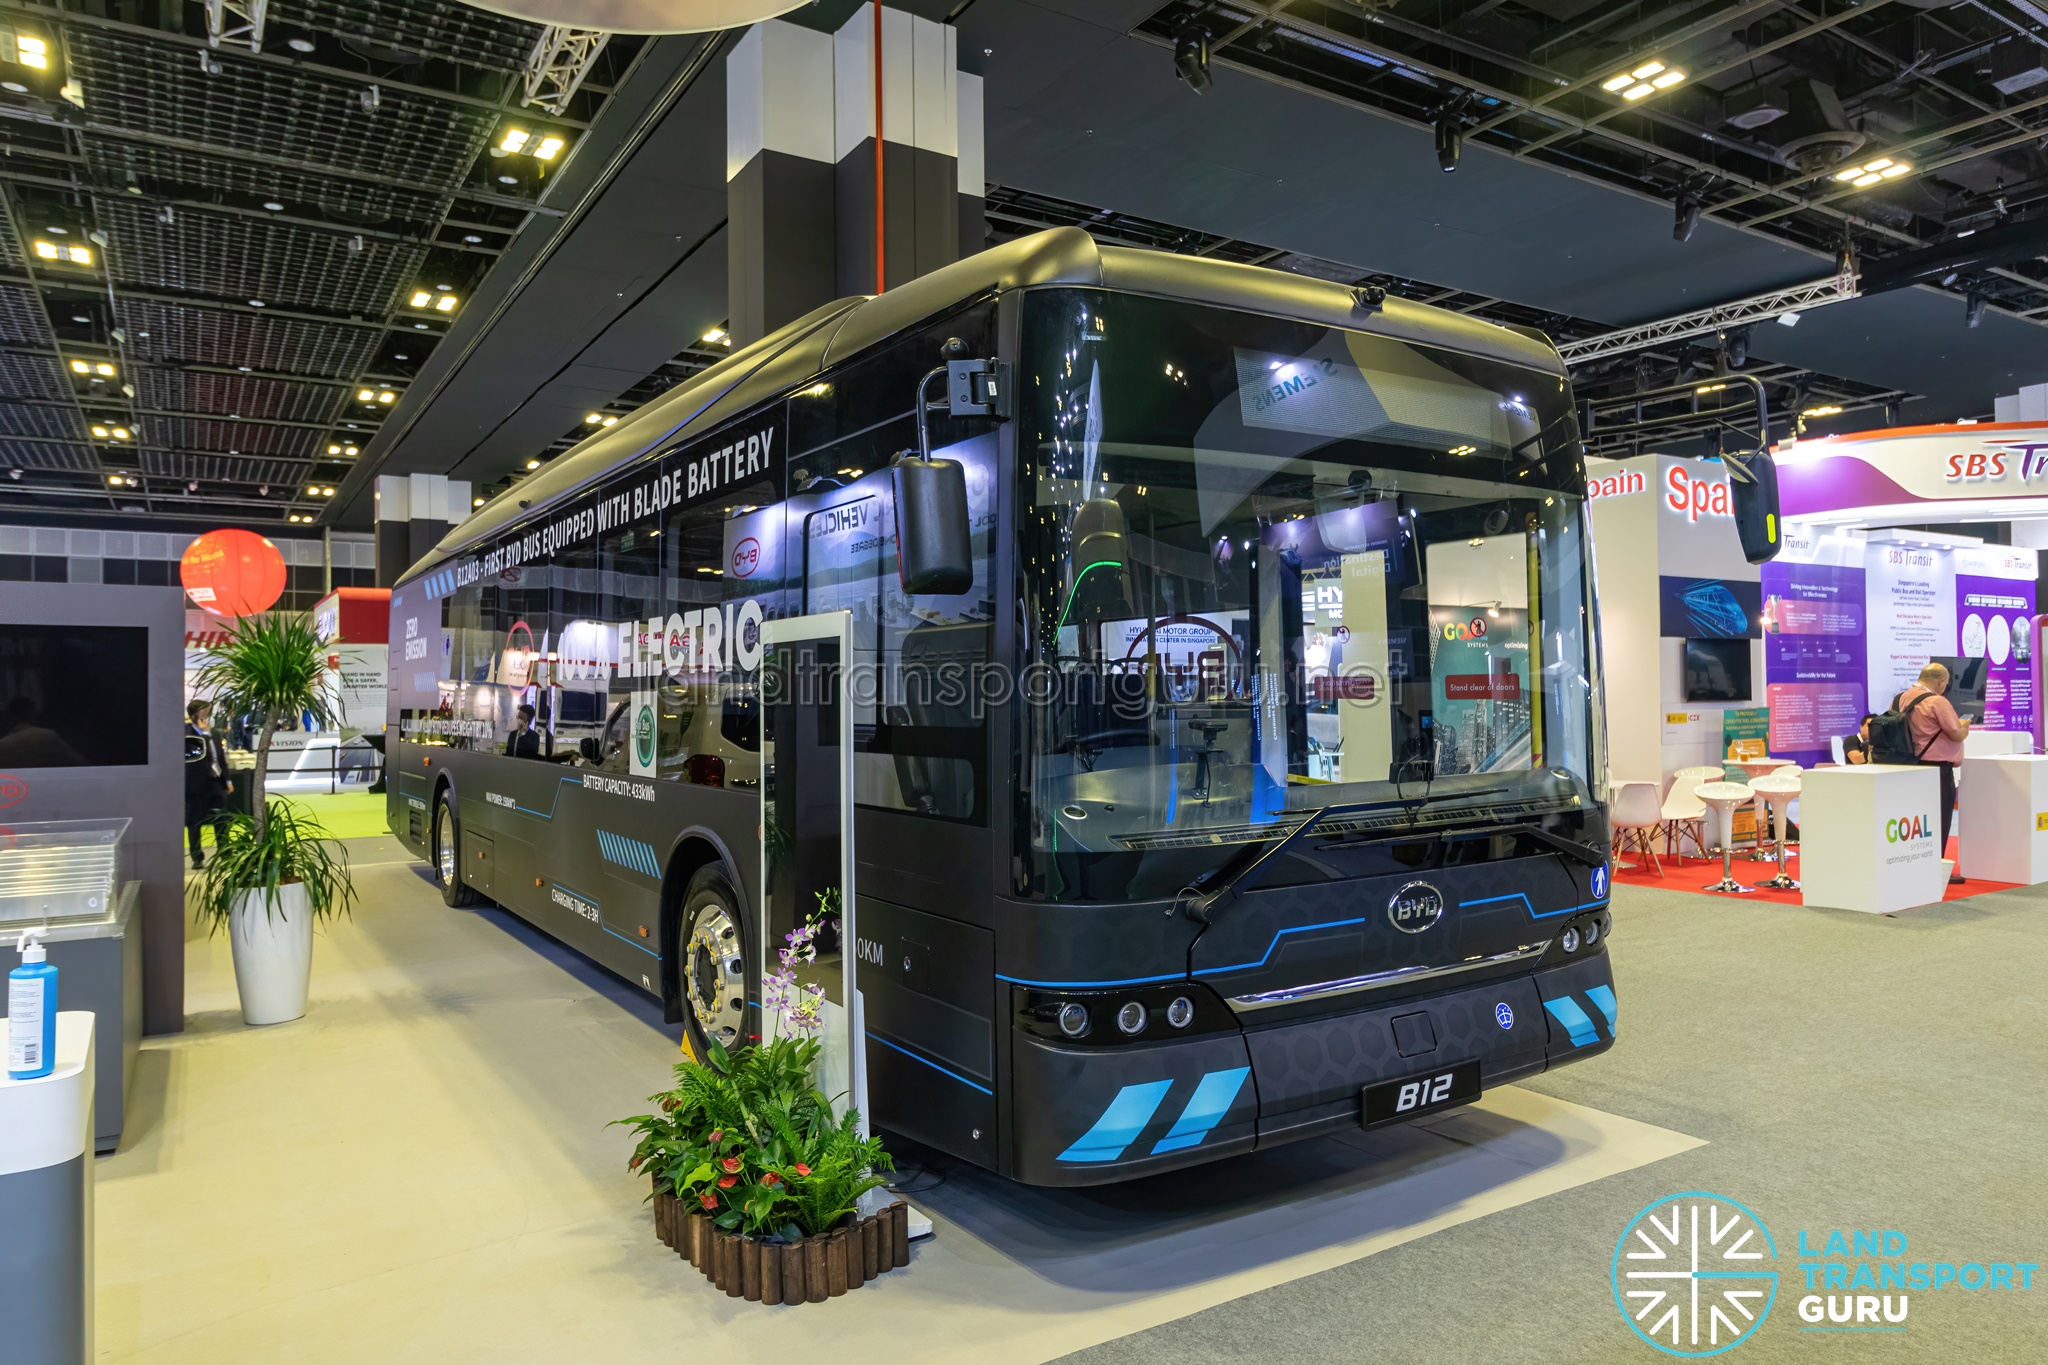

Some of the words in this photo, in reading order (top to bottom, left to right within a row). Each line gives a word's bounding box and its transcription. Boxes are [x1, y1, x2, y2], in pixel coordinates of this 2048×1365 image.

[1946, 452, 2007, 478] SBS
[2005, 443, 2048, 481] Tr
[1587, 468, 1645, 499] pain
[457, 558, 480, 588] B12A03
[484, 546, 505, 578] FIRST
[506, 541, 522, 569] BYD
[523, 533, 542, 563] BUS
[542, 508, 595, 559] EQUIPPED
[597, 490, 631, 534] WITH
[633, 467, 682, 520] BLADE
[687, 426, 775, 499] BATTERY
[1783, 534, 1811, 549] Transit
[1889, 550, 1903, 564] SBS
[1902, 548, 1934, 567] Transit
[1317, 586, 1343, 603] HY
[405, 616, 418, 639] ZERO
[617, 599, 764, 679] ELECTRIC
[1129, 626, 1162, 635] HYUAI
[1162, 627, 1188, 636] MOTOR
[1188, 627, 1213, 636] GROUP
[1444, 622, 1489, 641] GO
[405, 637, 428, 661] EMISSION
[1187, 637, 1216, 645] SINGAPORE
[1504, 642, 1528, 650] optimizing
[1450, 683, 1468, 692] Stand
[1470, 683, 1485, 691] clear
[1487, 683, 1494, 691] of
[1496, 683, 1515, 691] doors
[583, 774, 605, 792] BATTERY
[604, 778, 632, 798] CAPACITY:
[631, 783, 656, 802] 433kWh
[1885, 814, 1933, 844] GOAL
[1886, 853, 1911, 865] optimizing
[1910, 851, 1921, 862] your
[1921, 849, 1933, 859] world
[1910, 841, 1933, 851] SYSTEMS
[551, 888, 575, 912] CHARGING
[574, 899, 587, 918] TIME:
[586, 906, 599, 924] 2-3H
[1397, 896, 1438, 921] BYD
[1396, 1072, 1454, 1113] B12
